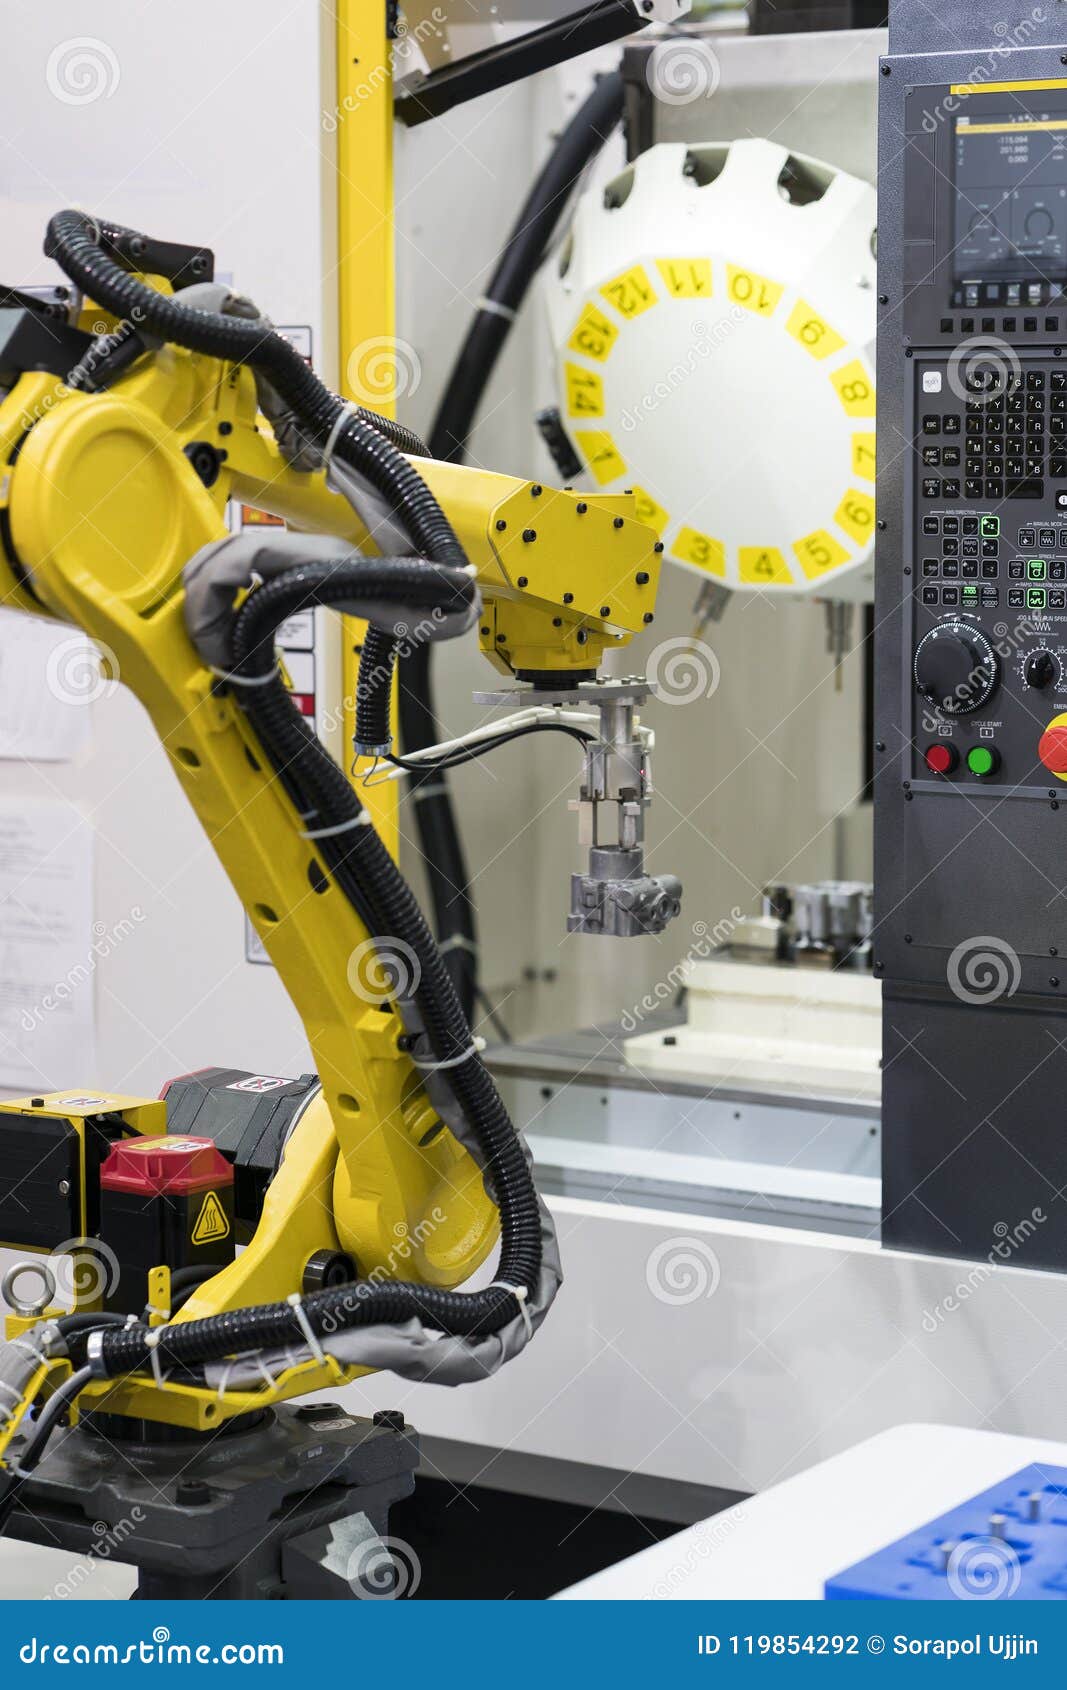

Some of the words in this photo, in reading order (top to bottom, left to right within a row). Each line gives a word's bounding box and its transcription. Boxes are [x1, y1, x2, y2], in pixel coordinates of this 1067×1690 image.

[669, 265, 705, 292] 11
[609, 277, 650, 313] 12
[731, 274, 768, 309] 10
[577, 318, 610, 357] 13
[994, 380, 1001, 388] N
[1014, 379, 1021, 387] G
[1060, 379, 1066, 387] 7
[572, 376, 598, 413] 14
[840, 379, 870, 403] 8
[974, 401, 980, 409] X
[994, 401, 1001, 409] Y
[1015, 401, 1021, 409] Z
[1035, 401, 1042, 409] Q
[1058, 400, 1065, 409] 4
[1035, 422, 1041, 430] R
[973, 444, 981, 452] M
[994, 444, 1000, 452] S
[1014, 444, 1020, 452] T
[1034, 444, 1040, 452] L
[856, 445, 877, 462] 7
[994, 466, 1000, 474] D
[1034, 466, 1040, 474] B
[845, 501, 871, 525] 6
[690, 536, 711, 564] 3
[807, 538, 832, 566] 5
[753, 552, 774, 576] 4
